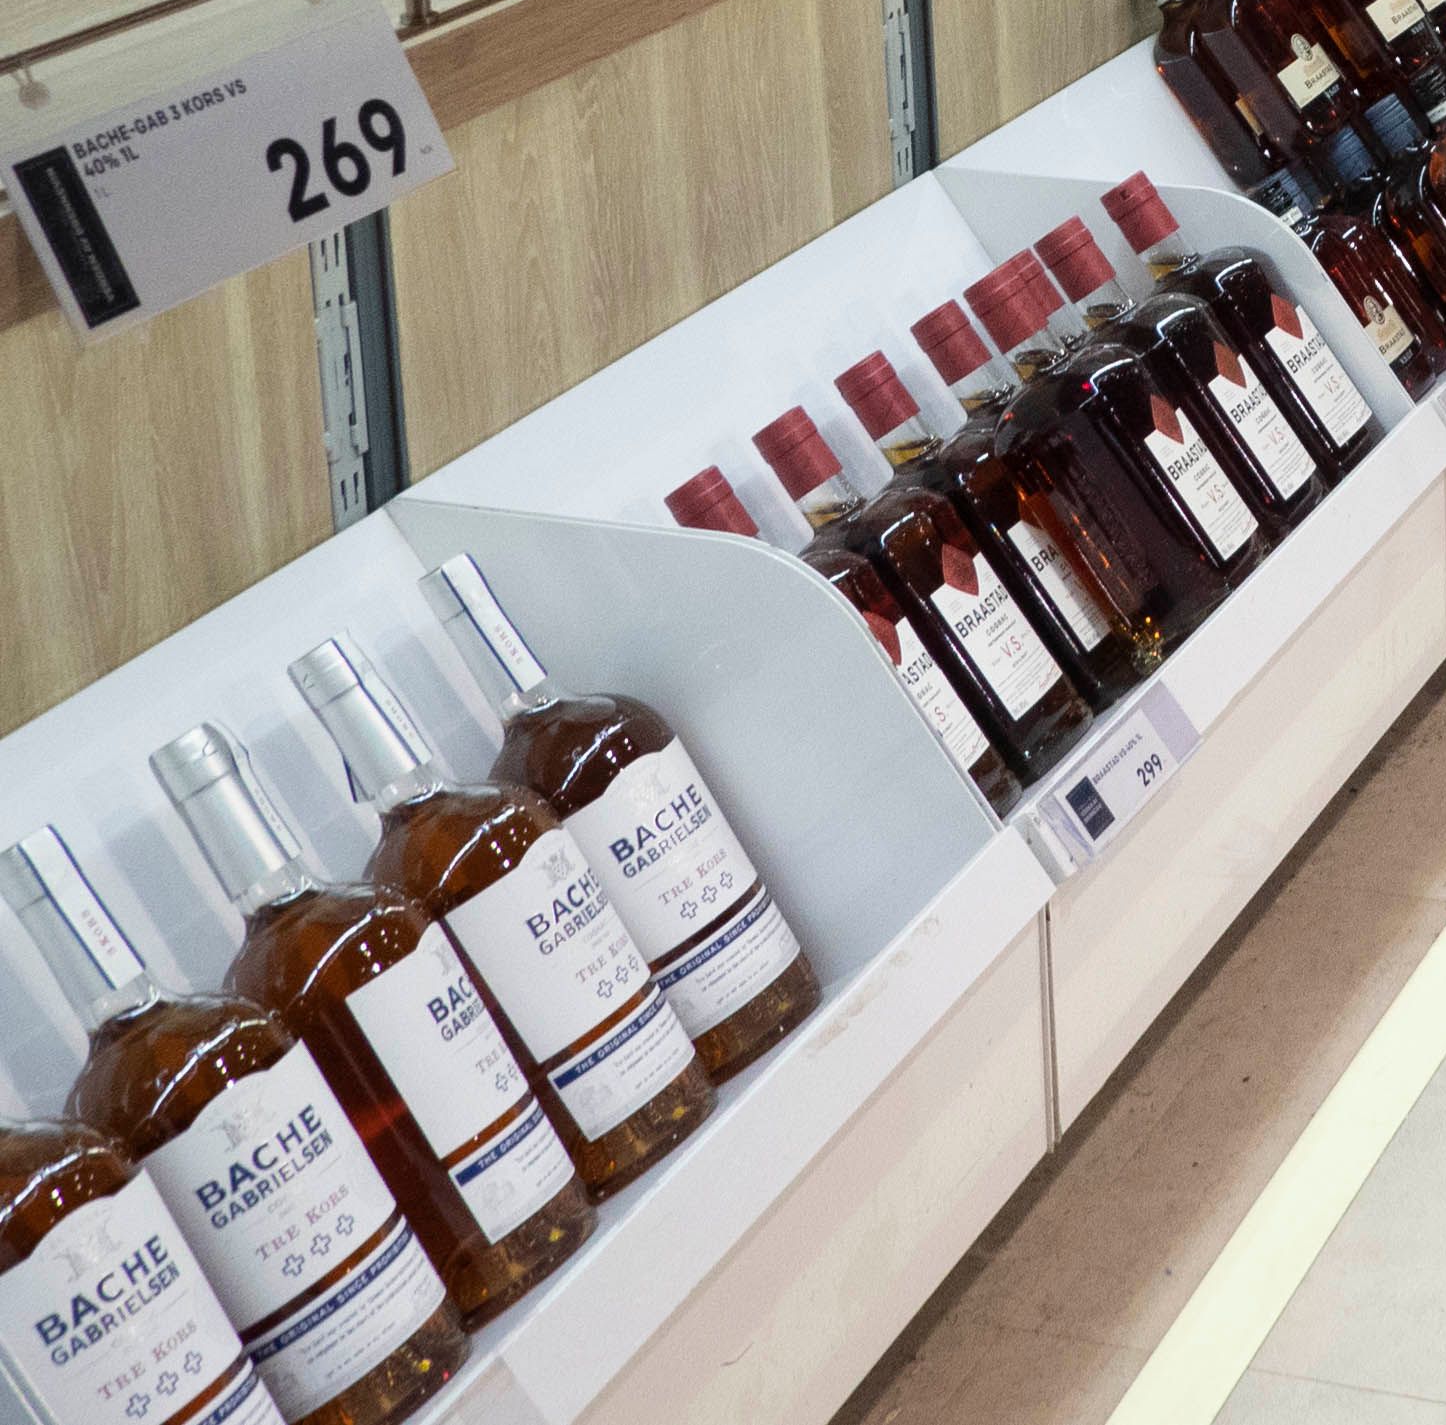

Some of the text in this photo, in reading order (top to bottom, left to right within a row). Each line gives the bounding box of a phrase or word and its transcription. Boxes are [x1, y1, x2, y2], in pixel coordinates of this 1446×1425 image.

[71, 77, 249, 161] BACHE-GAB 3 KORS VS
[82, 149, 121, 178] 40%
[264, 97, 408, 224] 269
[954, 583, 1010, 639] BRAASTAD
[1093, 754, 1121, 786] BRAASTAD
[1136, 752, 1164, 788] 299
[608, 783, 704, 866] BACHE
[621, 803, 713, 880] GABRIELSEN
[657, 847, 729, 907] TRE KORS
[575, 954, 608, 984] TRE
[679, 942, 722, 977] ORIGINAL
[426, 975, 473, 1025] BAC
[573, 1057, 596, 1077] THE
[596, 1026, 638, 1060] ORIGINAL
[192, 1103, 323, 1213] BACHE
[210, 1128, 335, 1231] GABRIELSEN
[477, 1154, 498, 1170] THE
[254, 1182, 352, 1262] TRE KORS
[33, 1233, 170, 1349] BACHE
[50, 1260, 183, 1368] GABRIELSEN
[280, 1299, 337, 1344] ORIGINAL
[335, 1277, 371, 1312] SINCE
[97, 1319, 199, 1402] TRE KORS
